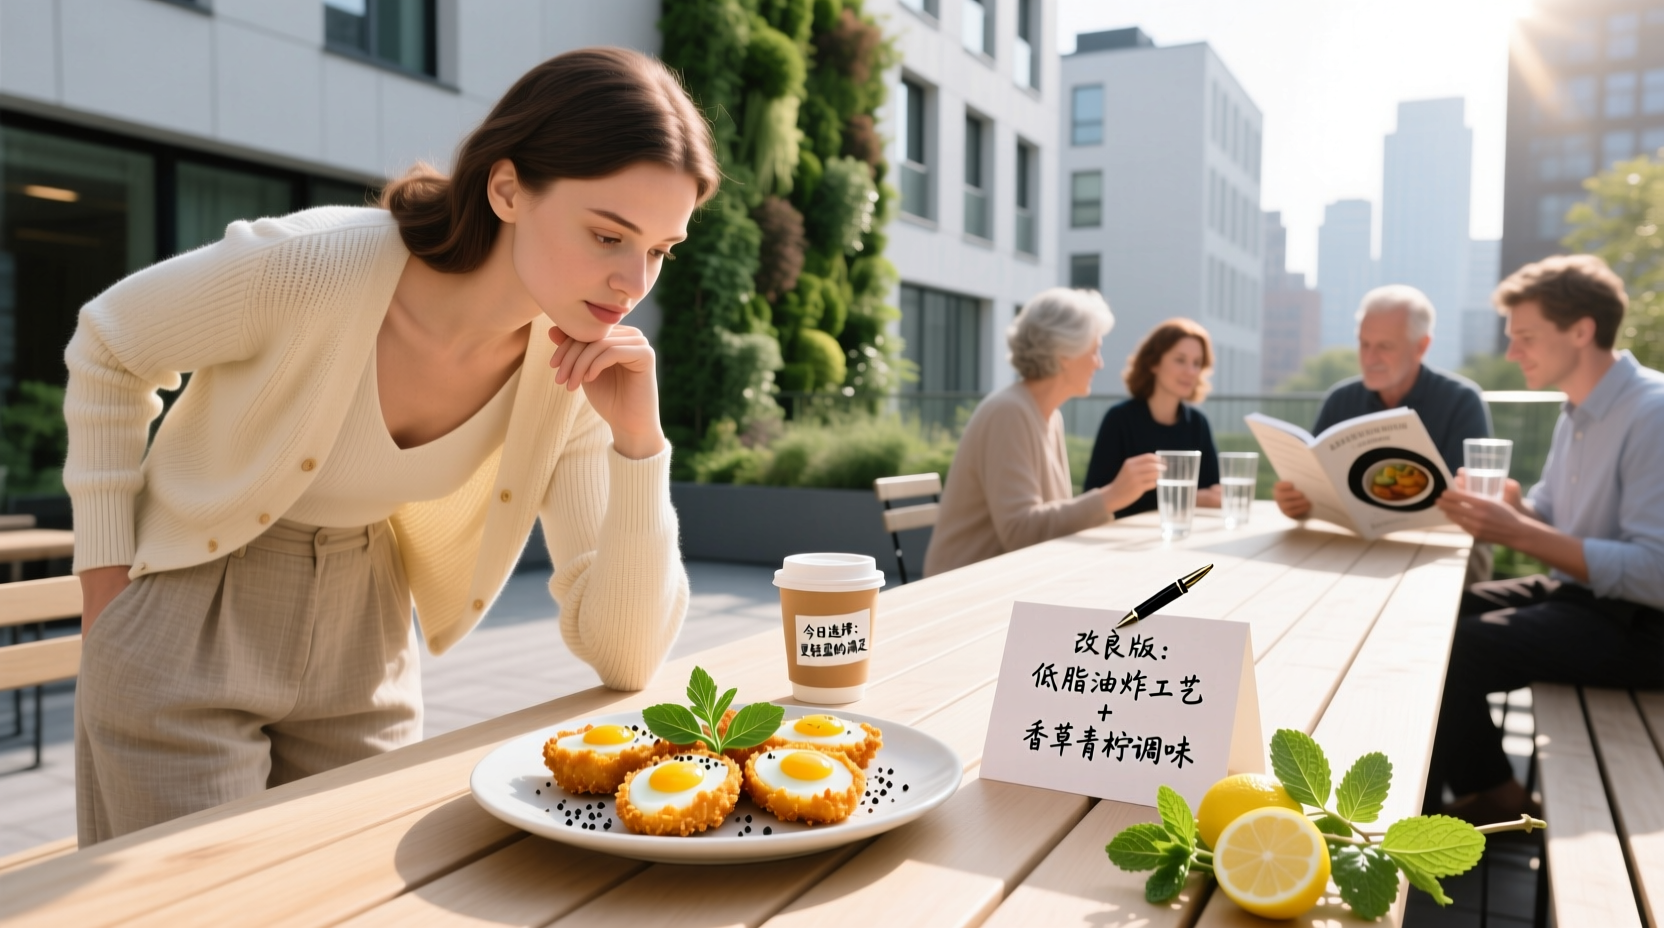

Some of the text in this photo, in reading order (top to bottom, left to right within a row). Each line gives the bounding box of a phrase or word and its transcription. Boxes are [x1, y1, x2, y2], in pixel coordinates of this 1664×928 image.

[1074, 629, 1168, 661] 改良版：
[1031, 662, 1203, 705] 低脂油炸工艺
[1097, 704, 1113, 722] +
[1022, 719, 1194, 770] 香草青柠调味
